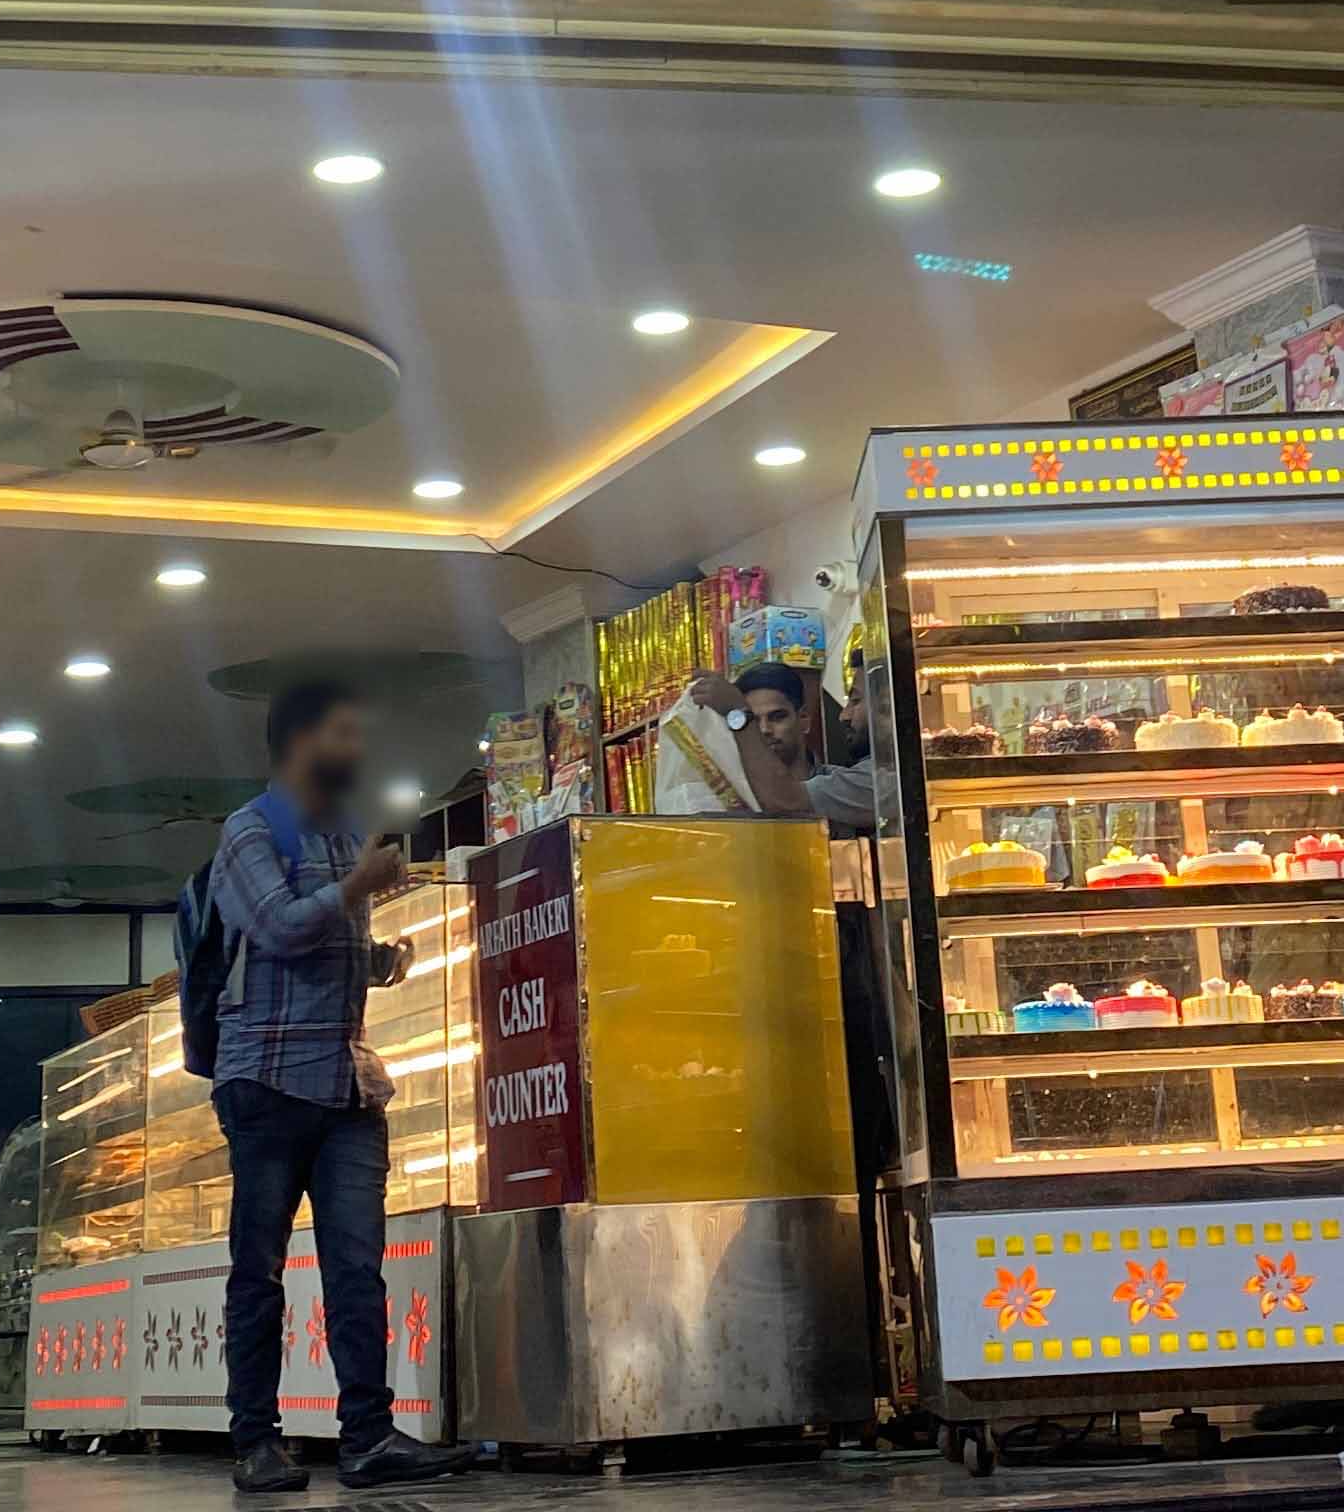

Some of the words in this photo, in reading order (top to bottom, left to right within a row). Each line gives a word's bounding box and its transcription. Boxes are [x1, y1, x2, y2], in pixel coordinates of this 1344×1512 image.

[524, 894, 570, 947] BAKERY
[499, 977, 546, 1038] CASH
[485, 1061, 569, 1128] COUNTER
